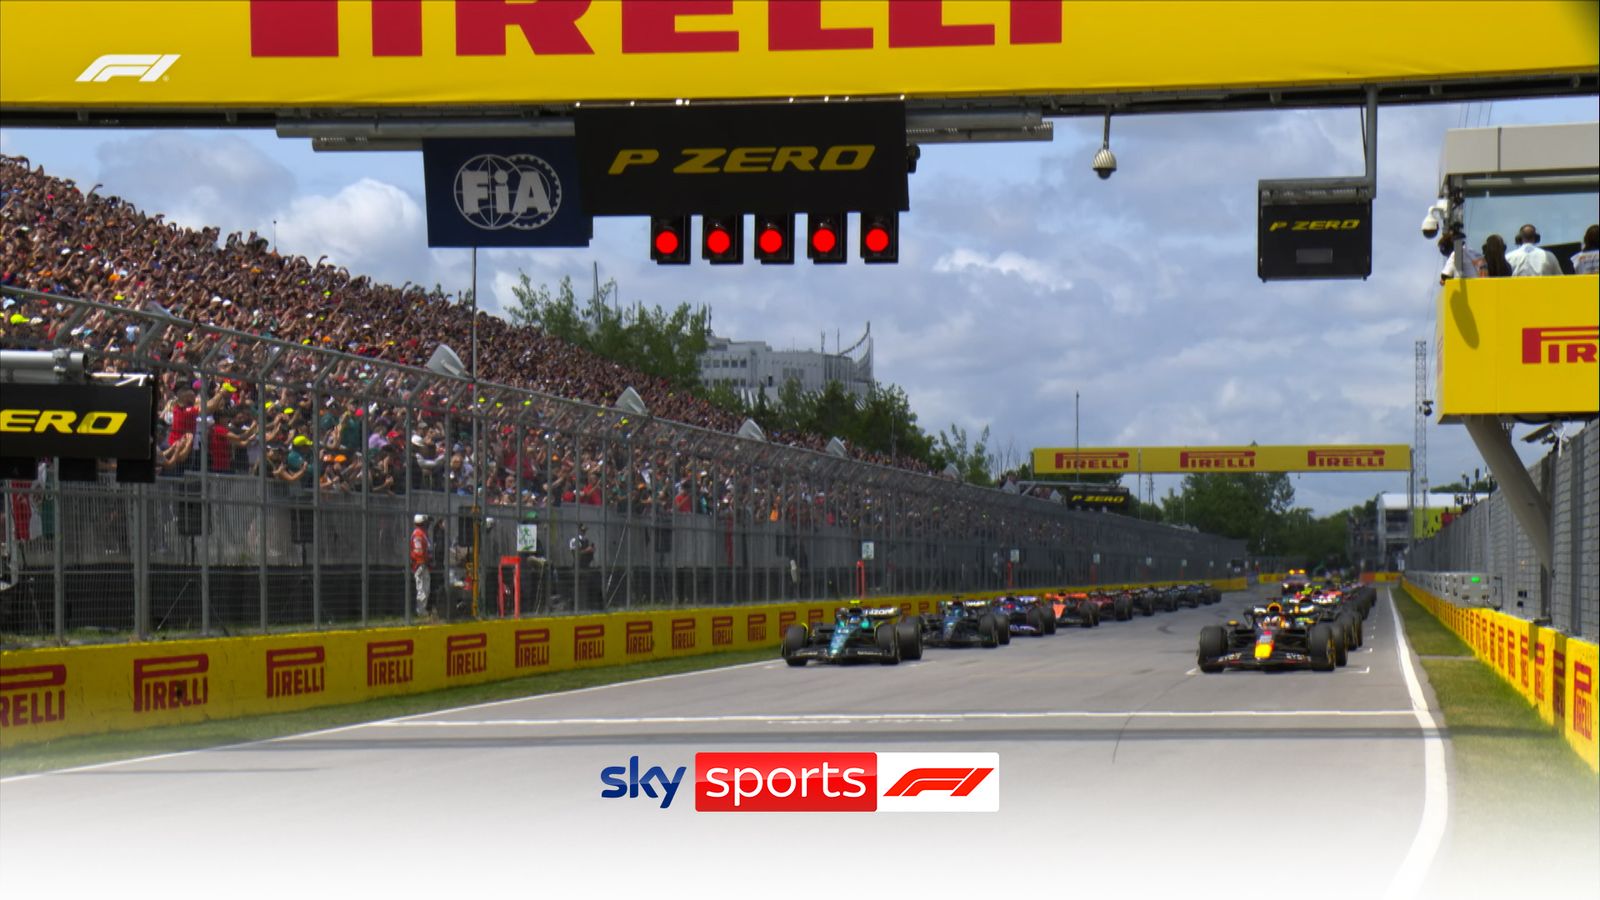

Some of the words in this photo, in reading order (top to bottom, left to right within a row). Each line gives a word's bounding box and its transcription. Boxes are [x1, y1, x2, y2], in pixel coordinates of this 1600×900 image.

[608, 149, 659, 175] P
[673, 145, 876, 173] ZERO
[1269, 221, 1287, 232] P
[1292, 219, 1360, 231] ZERO
[1055, 452, 1129, 469] PIRELLI
[1180, 451, 1256, 468] PIRELLI
[1307, 450, 1385, 467] PIRELLI
[133, 653, 209, 713] PIRELLI
[266, 646, 325, 699] PIRELLI
[367, 639, 414, 687] PIRELLI
[447, 633, 487, 677] PIRELLI
[515, 628, 550, 668] PIRELLI
[574, 624, 605, 661] PIRELLI
